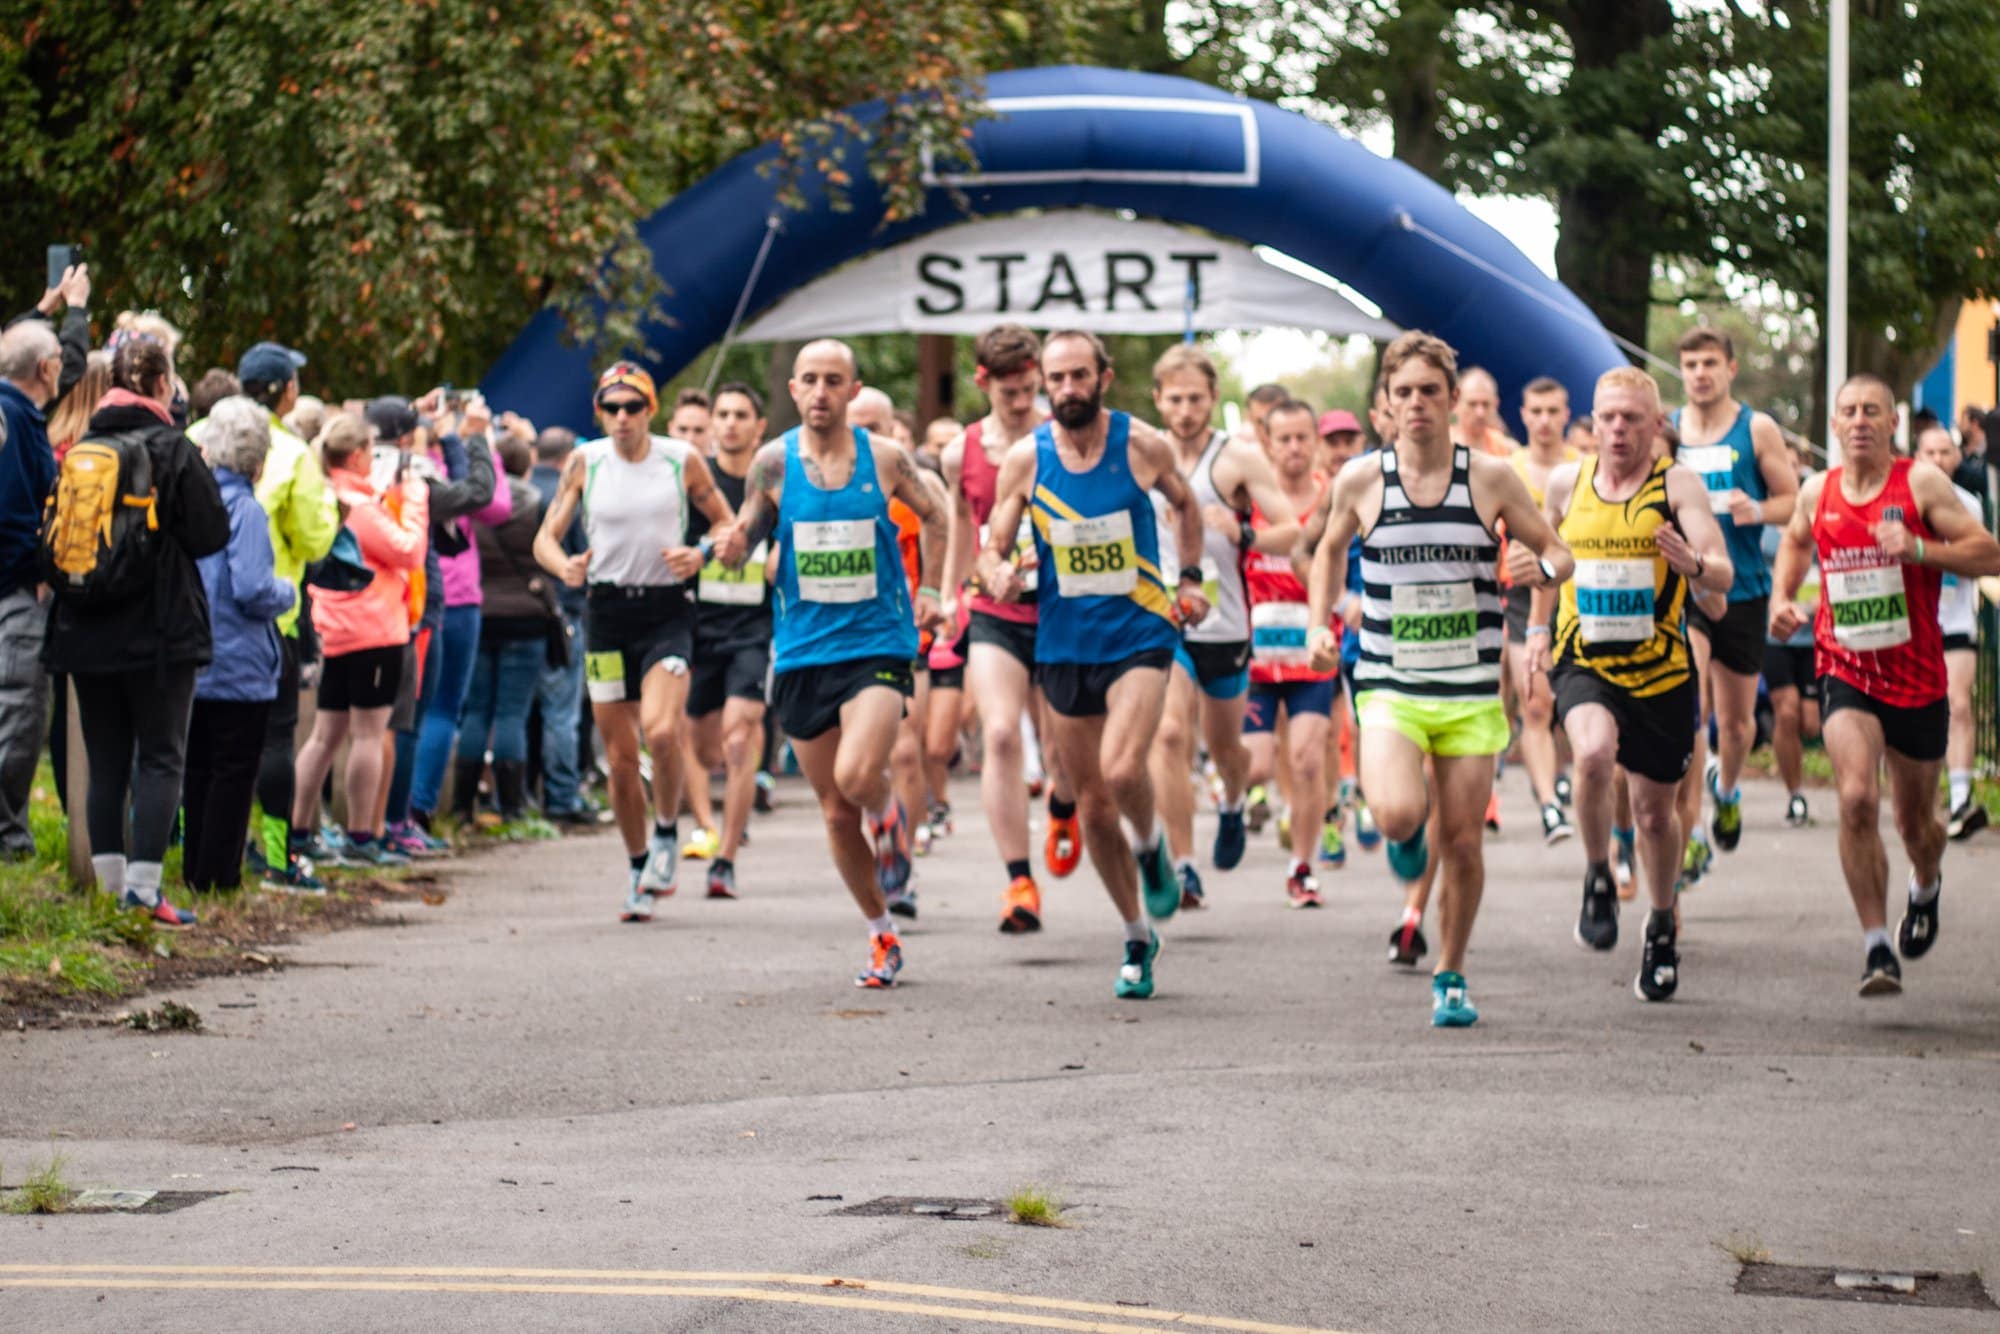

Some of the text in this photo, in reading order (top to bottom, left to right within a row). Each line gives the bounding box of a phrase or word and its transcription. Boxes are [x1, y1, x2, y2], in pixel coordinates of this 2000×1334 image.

[915, 252, 1219, 316] START
[798, 550, 873, 577] 2504A
[1068, 542, 1126, 574] 858
[1379, 545, 1480, 565] HIGHGATE
[1580, 590, 1648, 615] 3118A
[1834, 594, 1905, 626] 2502A
[1396, 613, 1472, 641] 2503A
